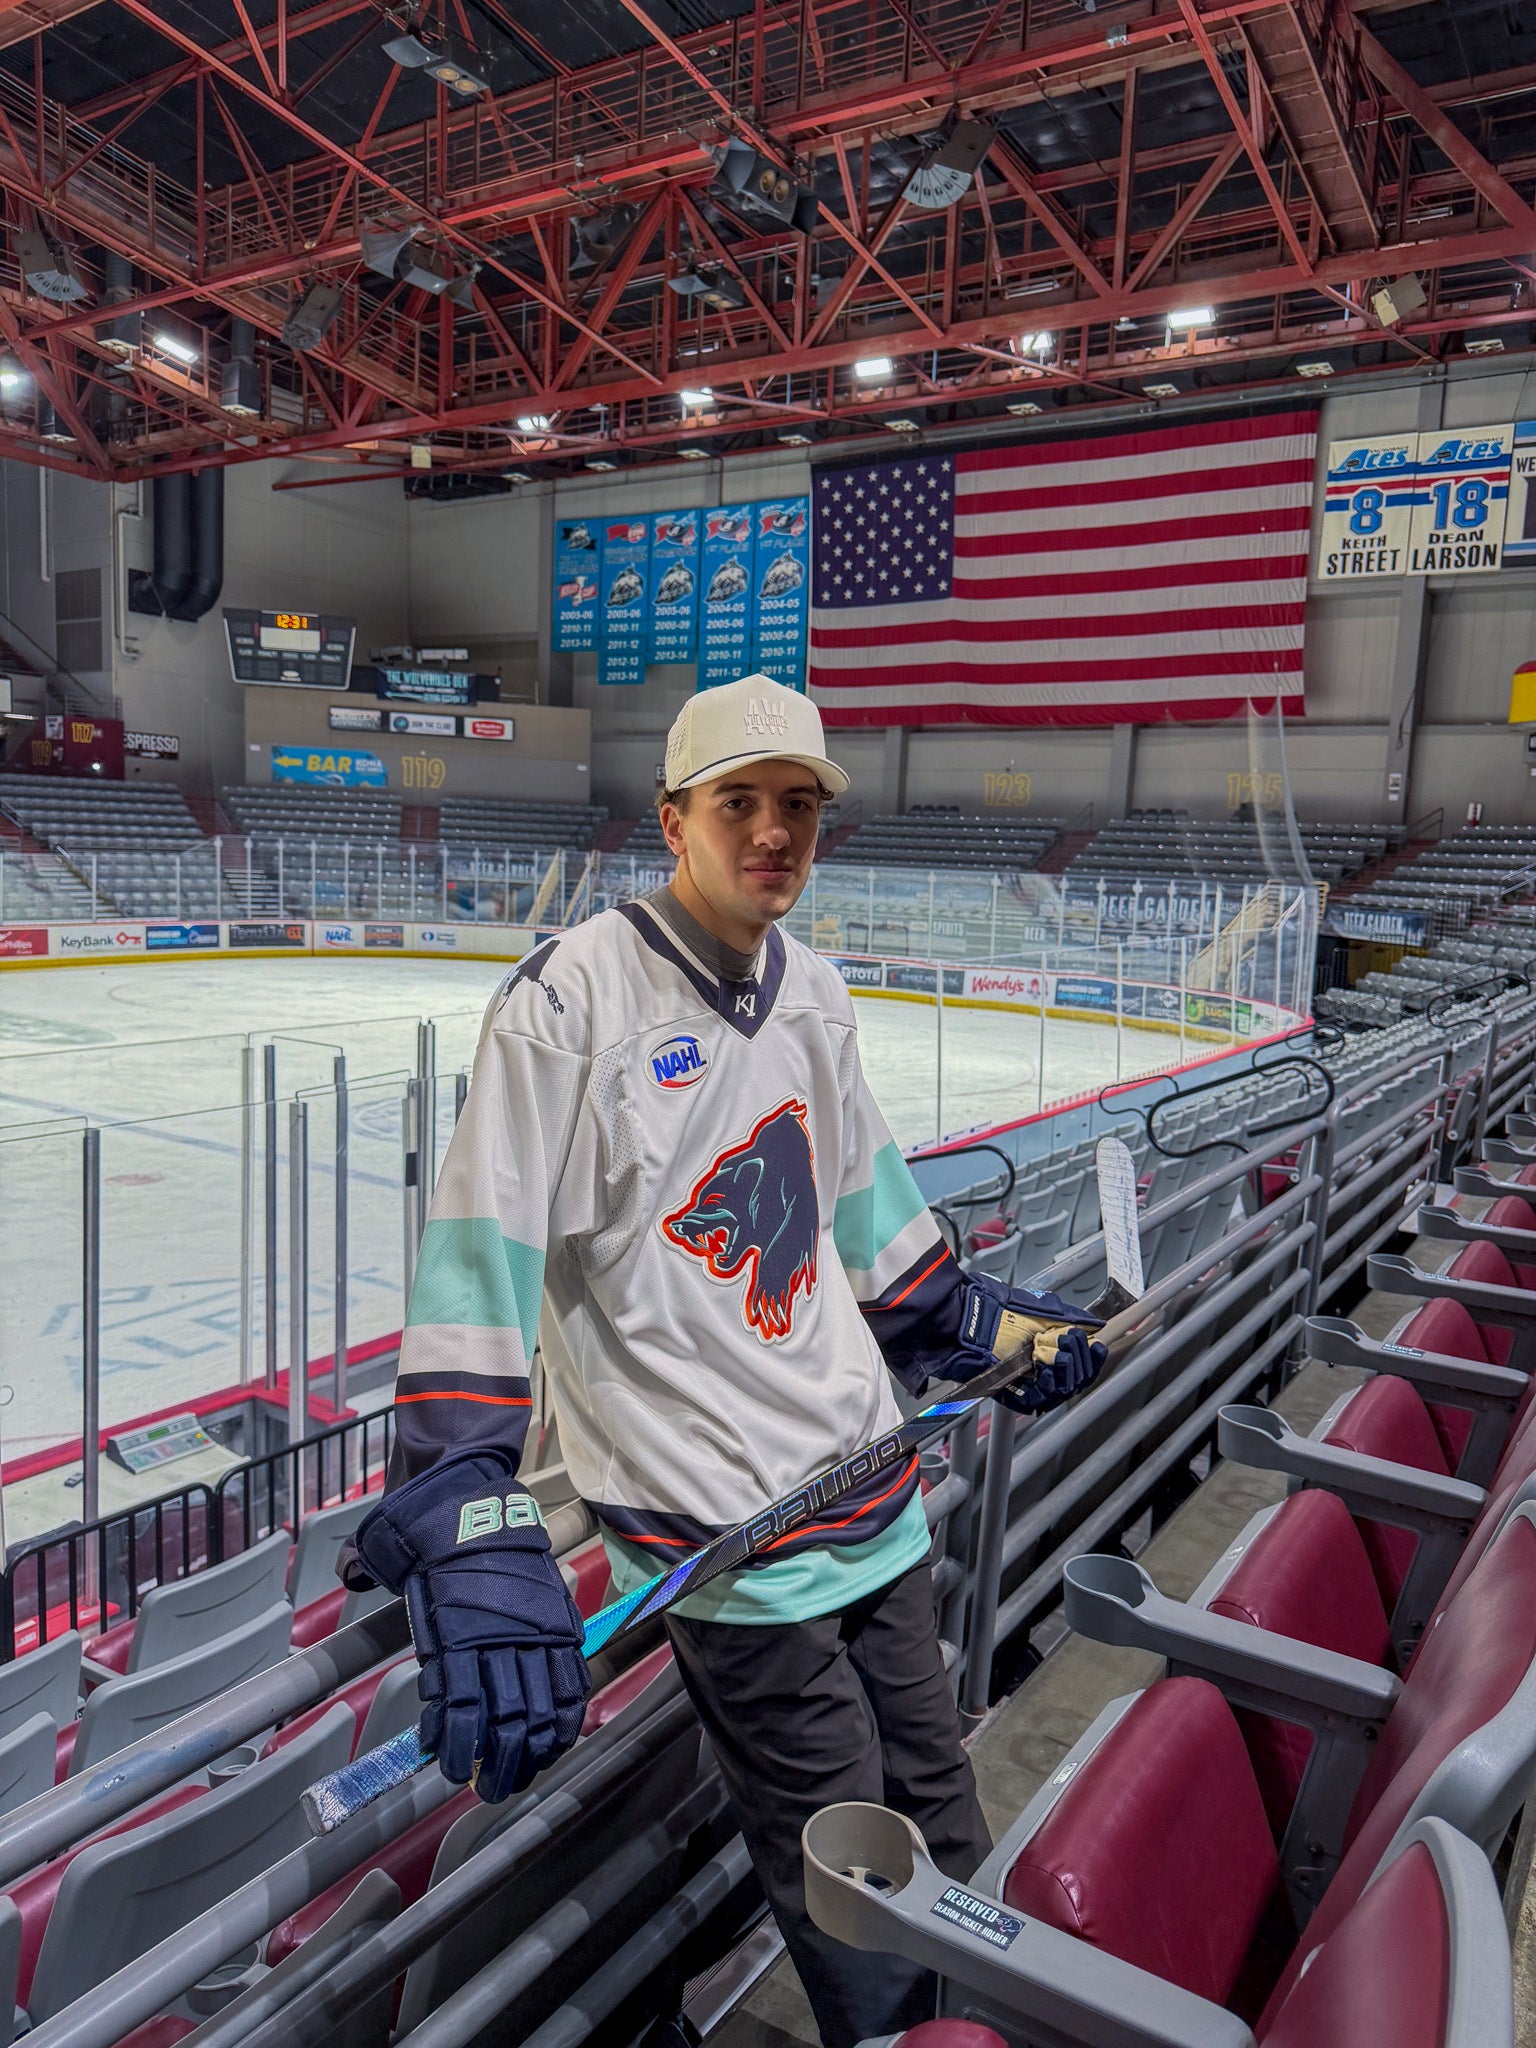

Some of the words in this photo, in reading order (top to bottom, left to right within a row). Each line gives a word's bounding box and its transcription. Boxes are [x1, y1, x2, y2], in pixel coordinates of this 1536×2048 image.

[1332, 449, 1408, 474] Aces
[1421, 440, 1503, 466] Aces
[1350, 488, 1383, 534] 8
[1433, 480, 1490, 530] 18
[1342, 535, 1387, 549] KEITH
[1428, 529, 1484, 544] DEAN
[1326, 549, 1401, 575] STREET
[1412, 544, 1498, 571] LARSON
[307, 754, 353, 773] BAR
[402, 756, 447, 788] 119
[984, 773, 1031, 806] 123
[1144, 897, 1212, 922] GARDEN
[61, 936, 115, 950] KeyBank
[972, 975, 1025, 996] Wendy's
[652, 1043, 707, 1083] NAHL
[943, 1888, 1000, 1923] RESERVED
[933, 1902, 960, 1921] SEASON
[959, 1914, 983, 1934] TICKET
[981, 1926, 1008, 1945] HOLDER
